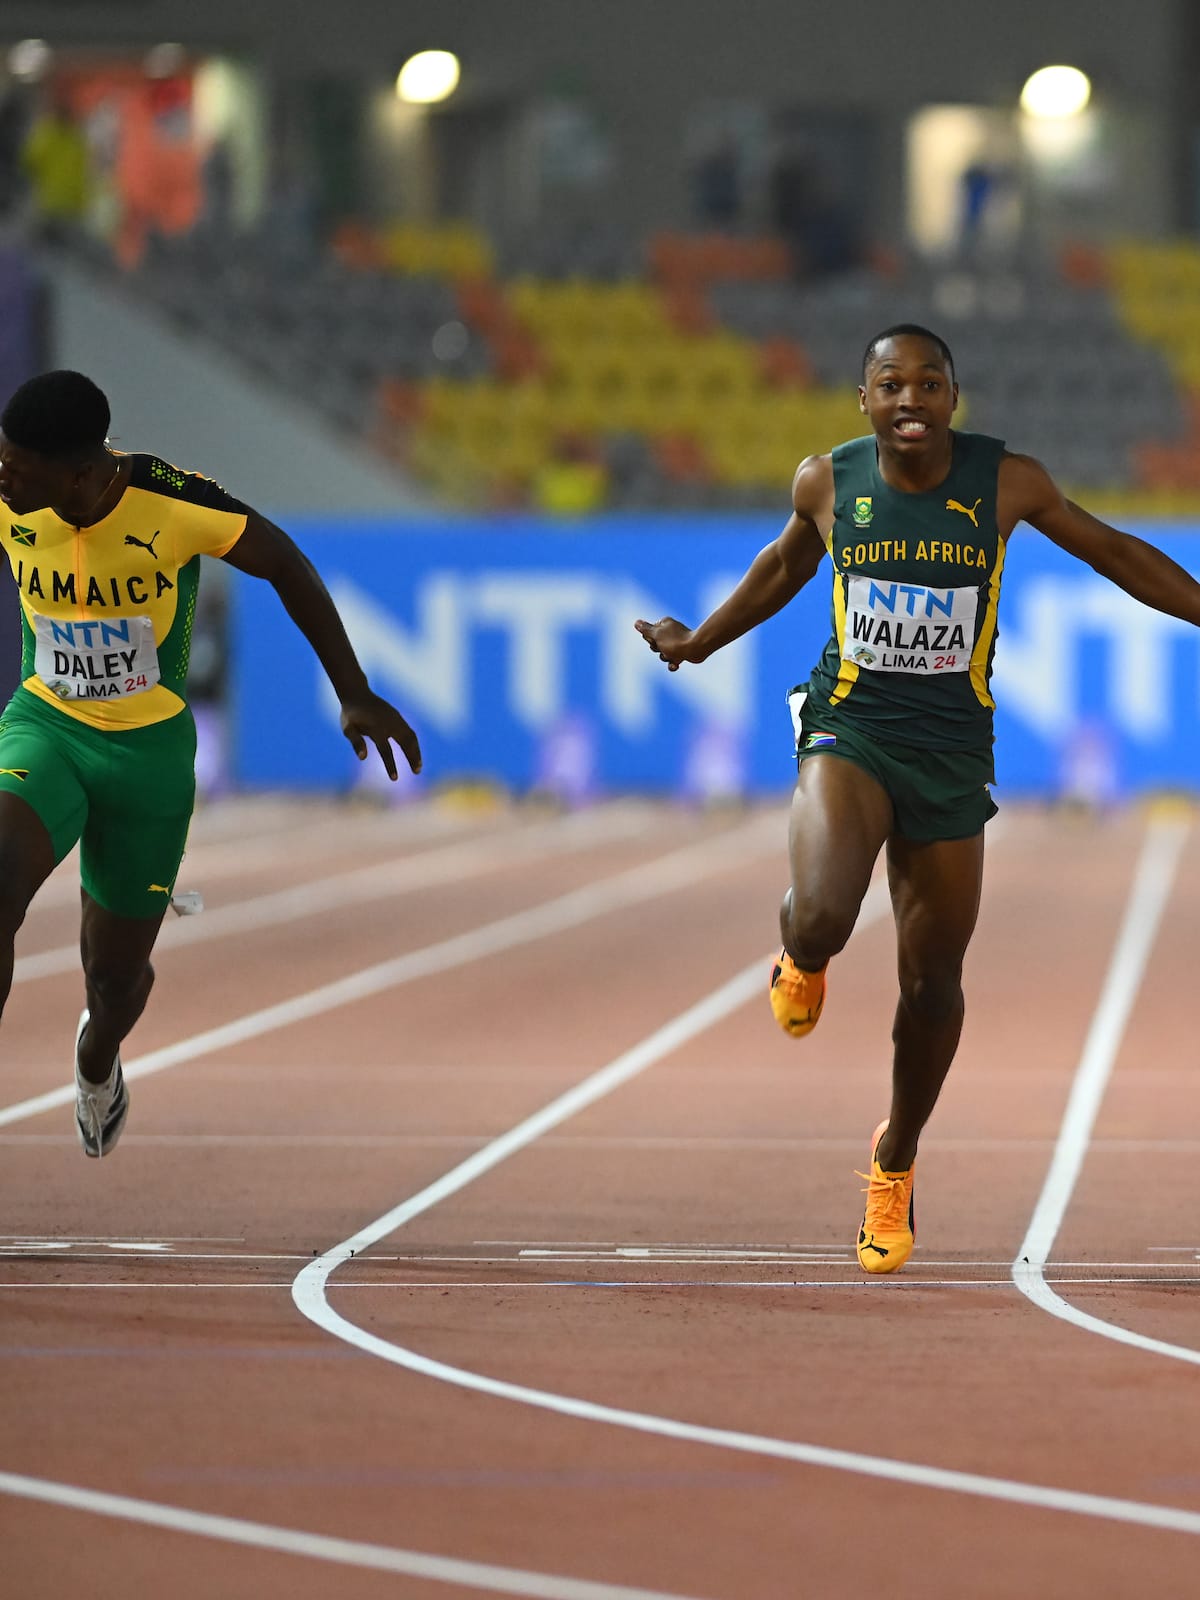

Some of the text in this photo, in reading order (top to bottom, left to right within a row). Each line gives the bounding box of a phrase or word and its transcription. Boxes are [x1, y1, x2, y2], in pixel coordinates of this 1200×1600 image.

[841, 540, 987, 569] SOUTH AFRICA
[18, 560, 174, 607] JAMAICA
[868, 581, 955, 619] NTN
[51, 619, 129, 648] NTN
[852, 611, 965, 651] WALAZA
[53, 649, 137, 680] DALEY
[321, 570, 757, 737] NTN
[881, 653, 956, 670] LIMA 24
[76, 674, 148, 699] LIMA 24
